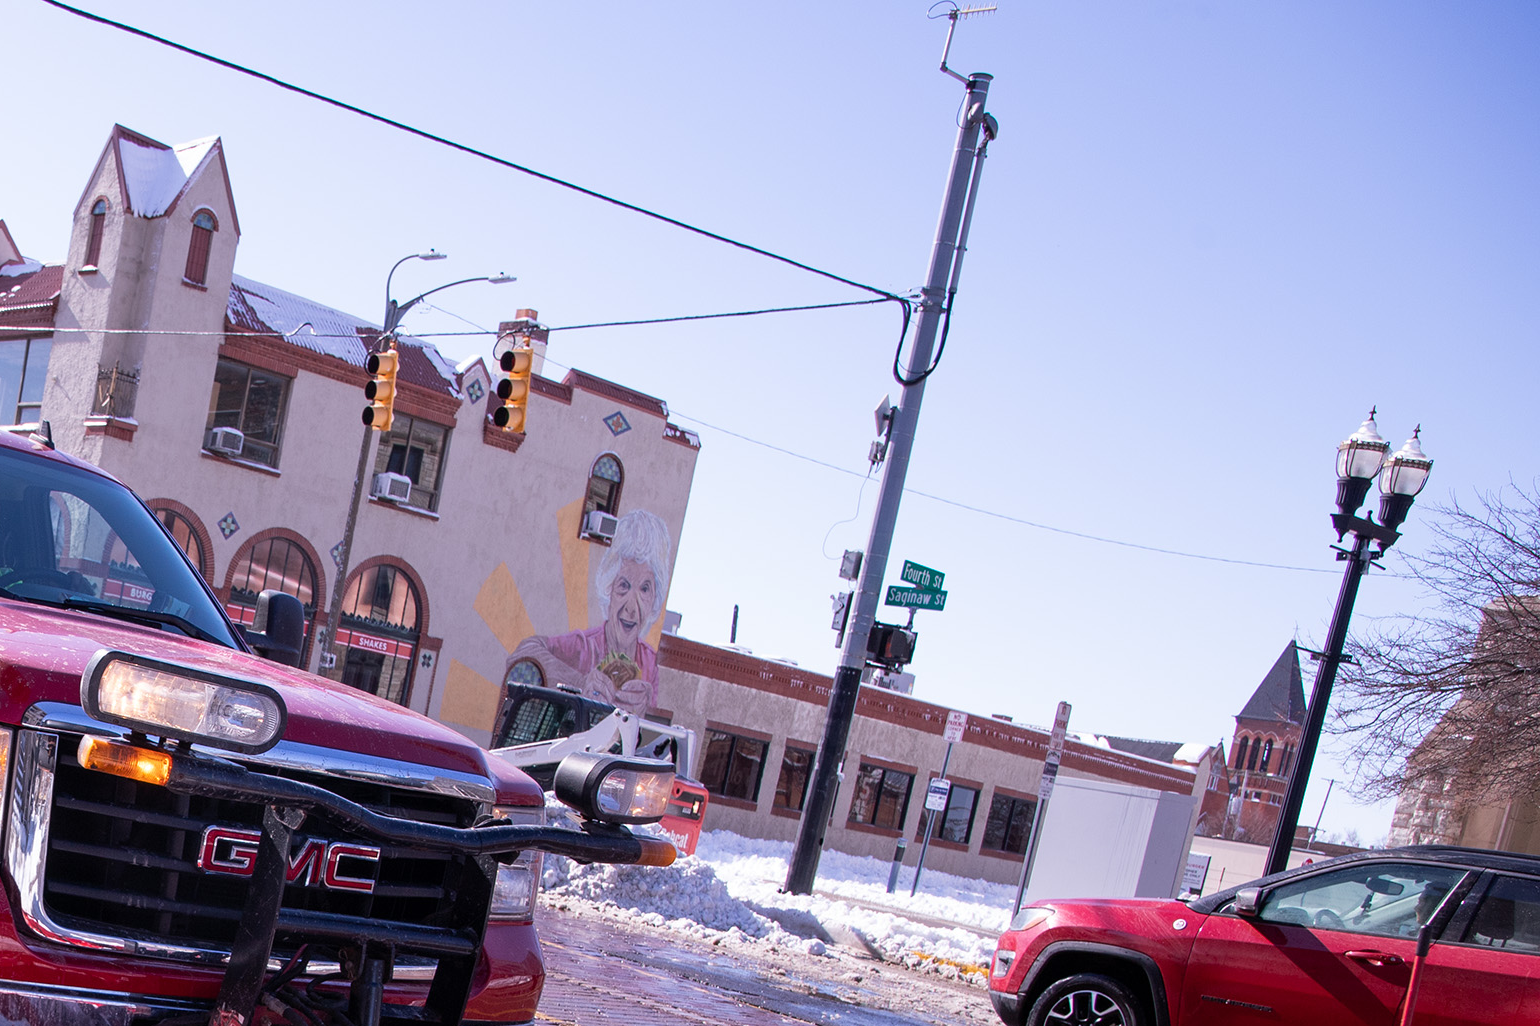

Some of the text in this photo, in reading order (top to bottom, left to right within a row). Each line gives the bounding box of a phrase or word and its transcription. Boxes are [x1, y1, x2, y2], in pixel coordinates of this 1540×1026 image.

[904, 563, 942, 588] Fourth St
[888, 588, 945, 606] Saginaw St
[359, 637, 388, 651] SHAKES
[198, 825, 381, 894] GMC
